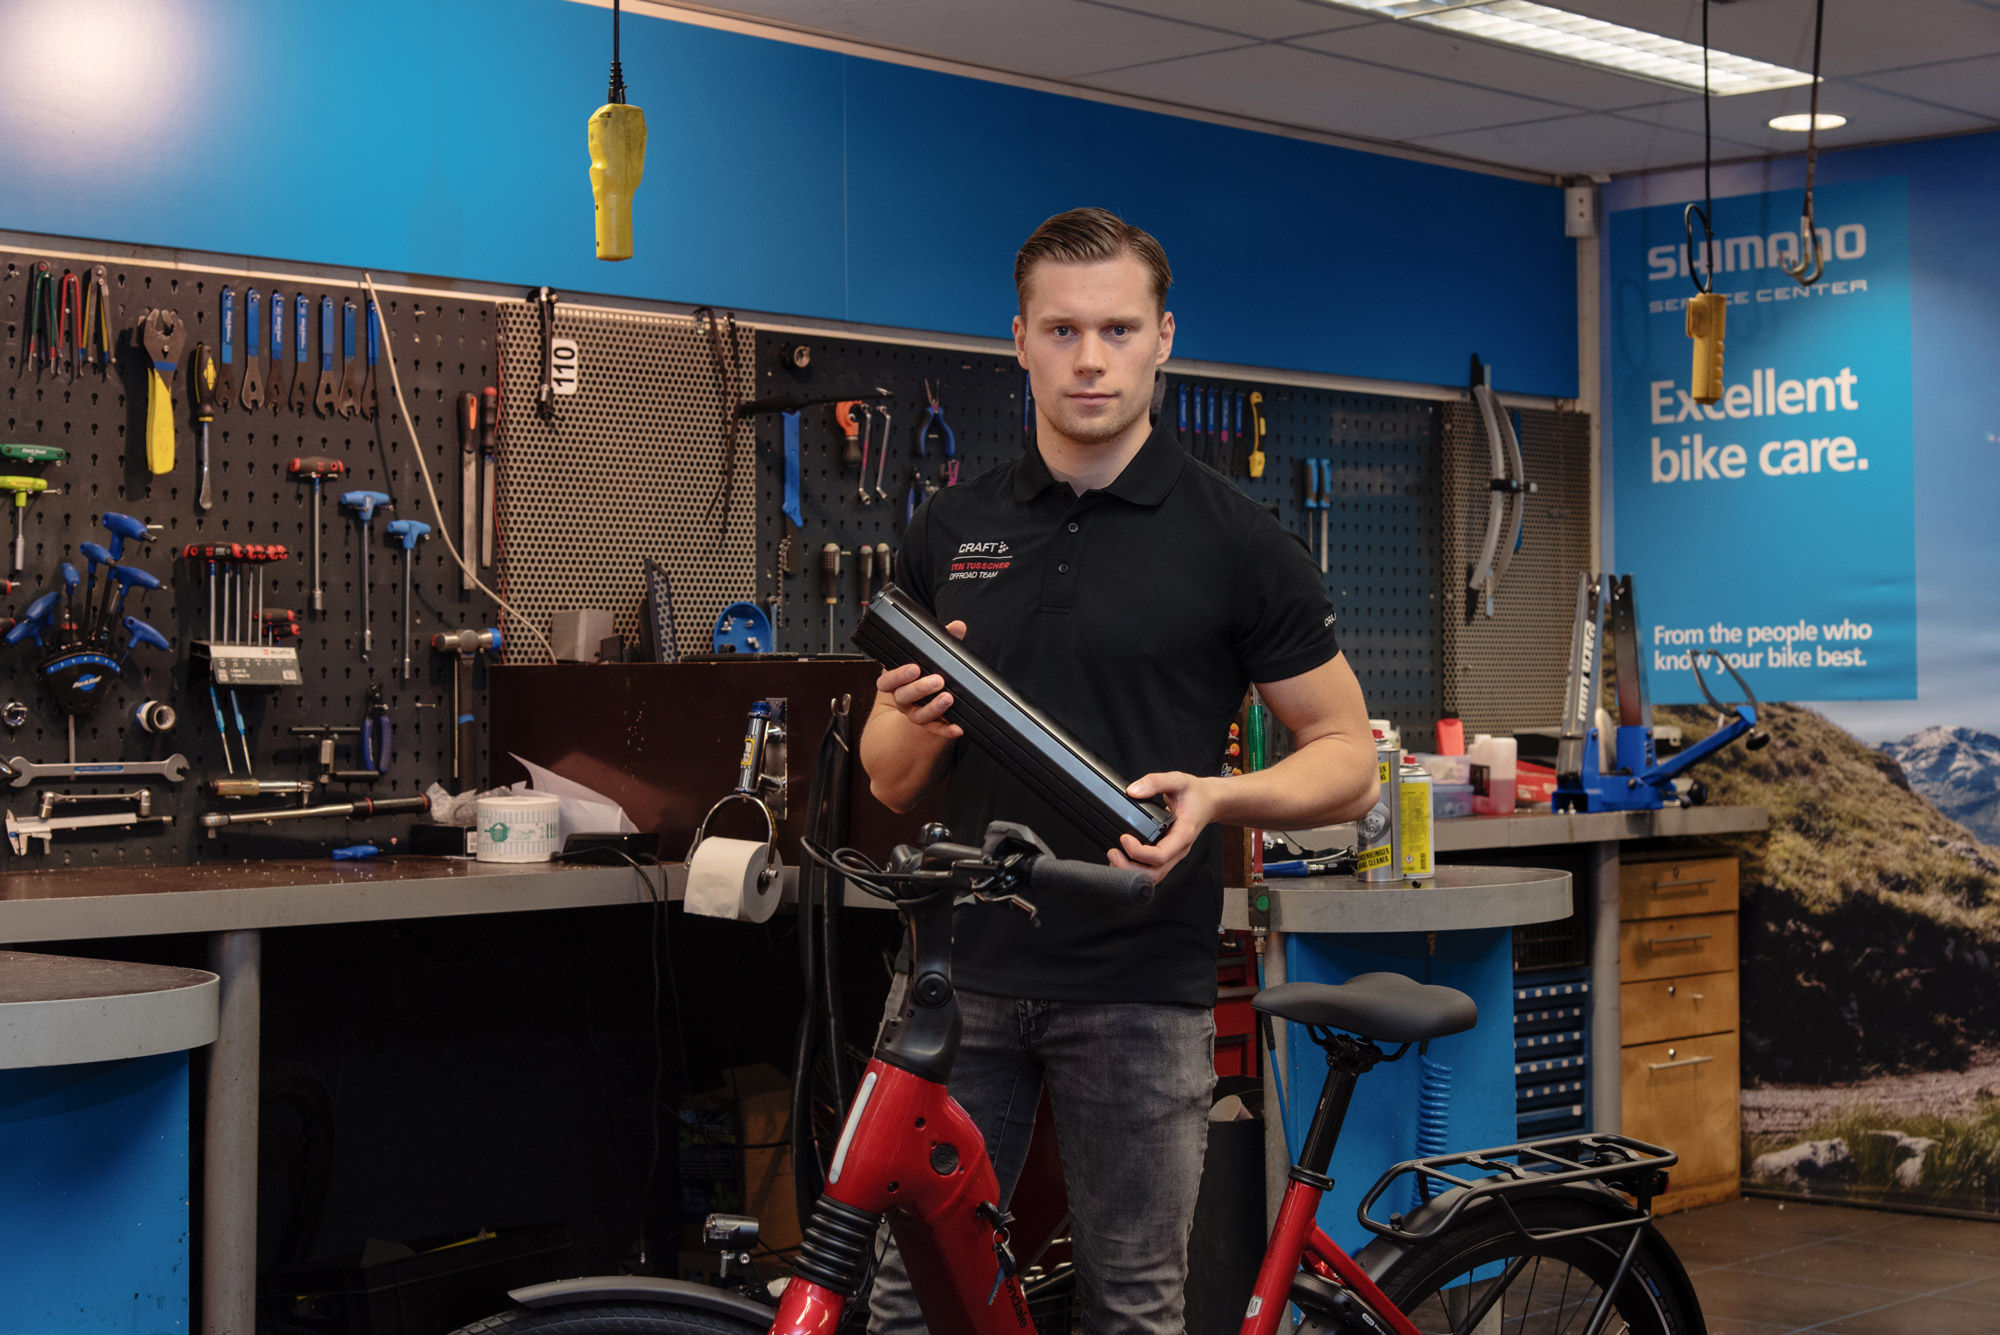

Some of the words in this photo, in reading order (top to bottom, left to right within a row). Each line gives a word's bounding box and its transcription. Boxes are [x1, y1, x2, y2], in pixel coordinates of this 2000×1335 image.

[1648, 223, 1867, 281] SHIMANO
[1756, 279, 1868, 302] CENTER
[553, 347, 575, 387] 110
[1651, 367, 1858, 425] Excellent
[1651, 433, 1748, 483] bike
[1758, 435, 1869, 476] care.
[958, 542, 999, 554] CRAFT
[949, 571, 978, 581] OFFROAD
[979, 571, 999, 579] TEAM
[951, 563, 965, 571] TEN
[966, 562, 1010, 570] TUSSCHER
[1654, 624, 1704, 646] From
[1708, 622, 1743, 644] the
[1747, 619, 1818, 649] people
[1822, 618, 1873, 642] who
[1654, 649, 1711, 671] know
[1715, 651, 1764, 675] your
[1767, 646, 1812, 668] bike
[1817, 645, 1867, 667] best.
[1005, 1278, 1028, 1329] ondale
